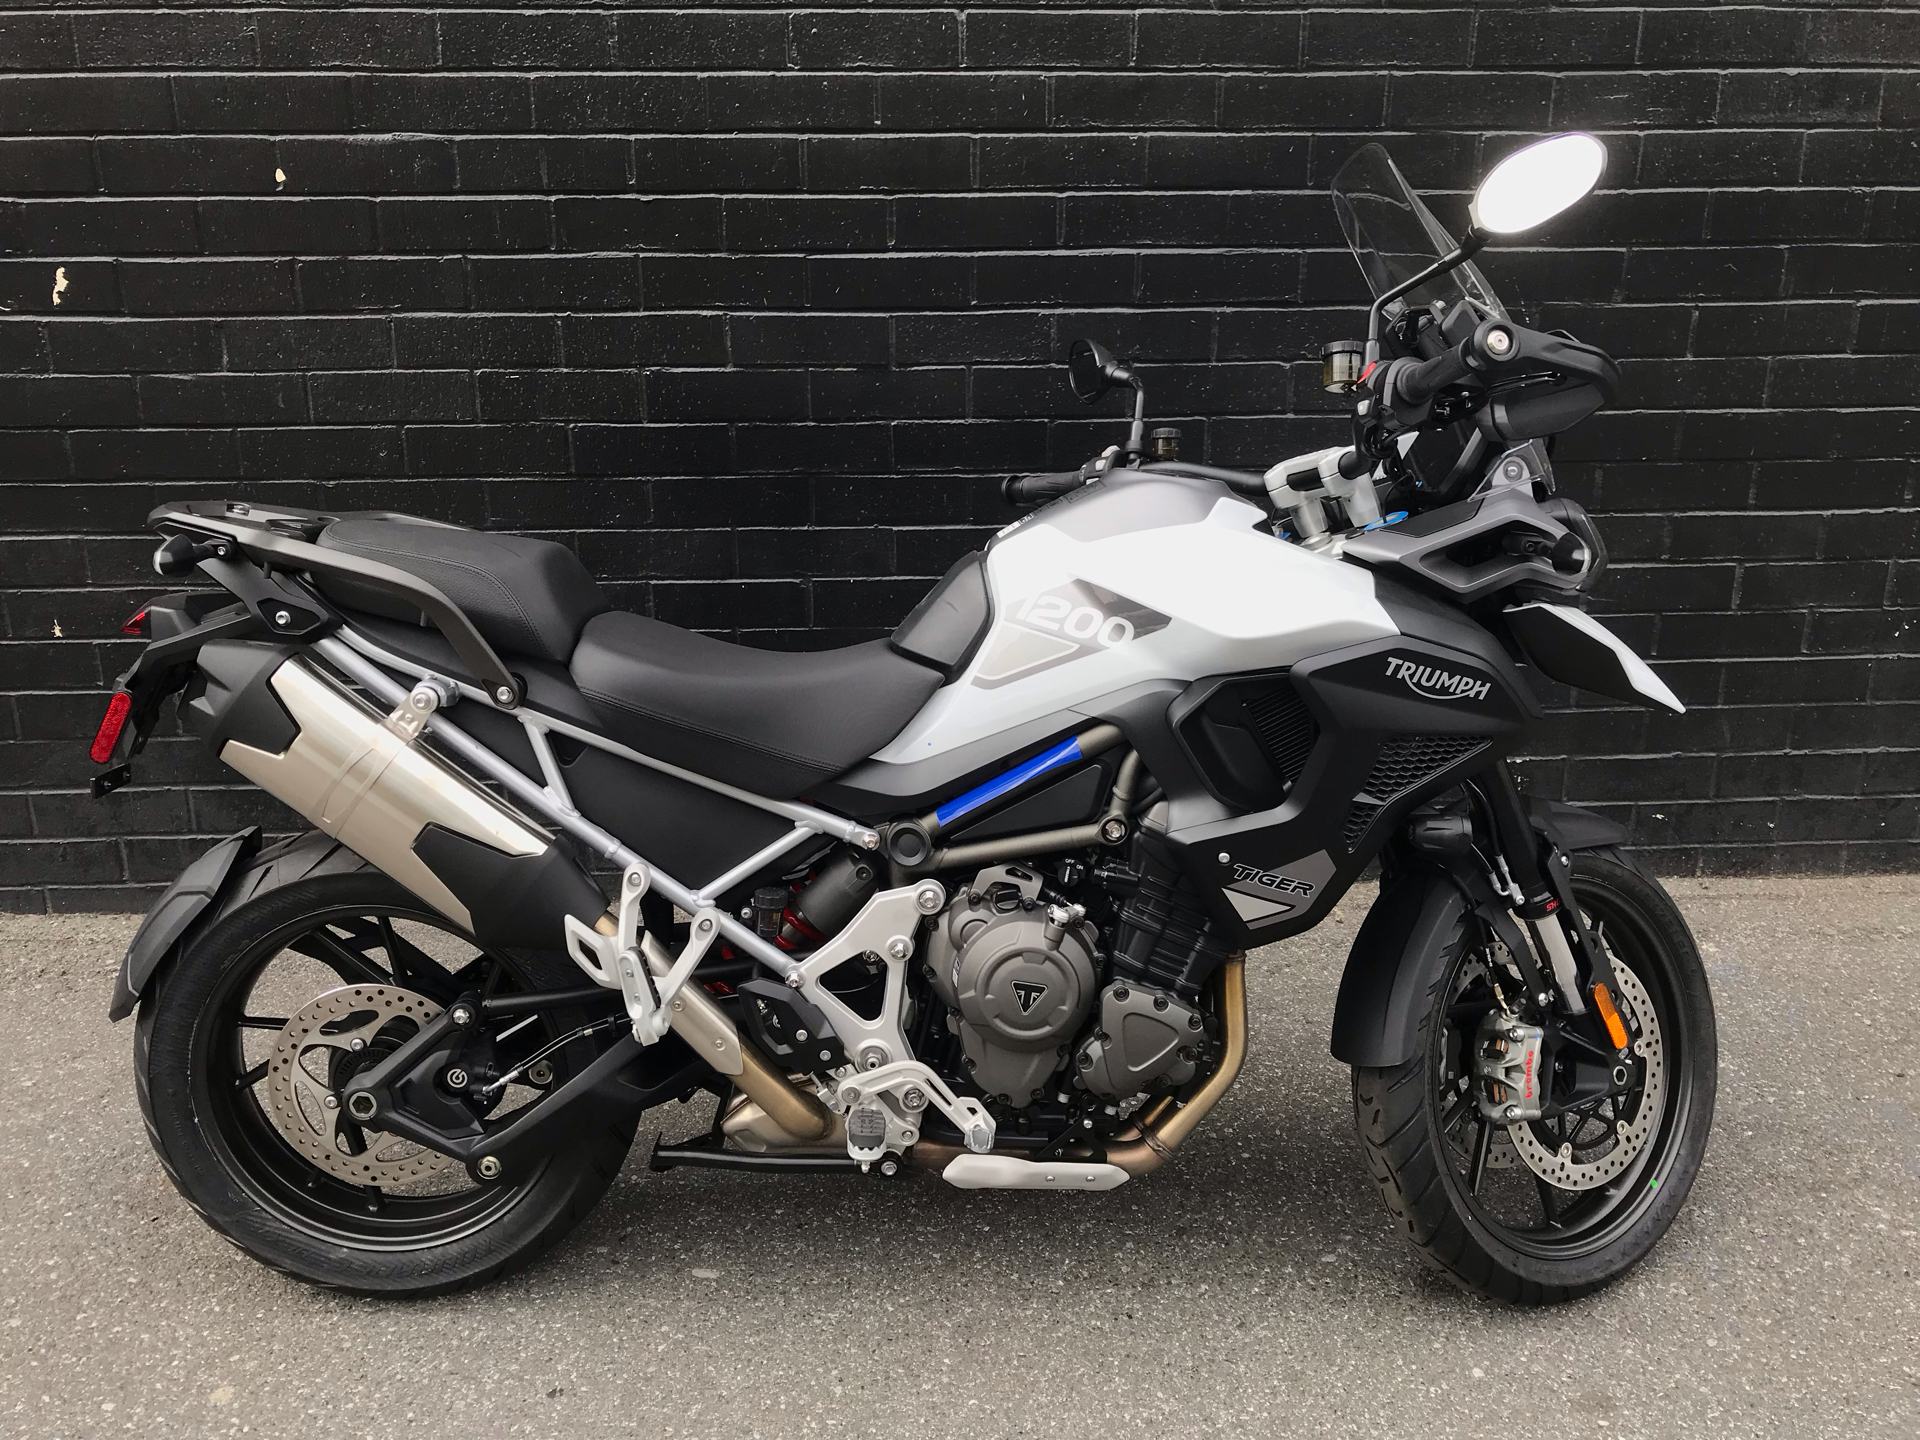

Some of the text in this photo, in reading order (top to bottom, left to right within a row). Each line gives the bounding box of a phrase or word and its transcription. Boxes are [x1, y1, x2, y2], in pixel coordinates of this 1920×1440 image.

[1016, 594, 1135, 651] 1200
[1385, 656, 1492, 700] TRIUMPH
[1233, 863, 1316, 898] TIGER
[1525, 1050, 1534, 1099] brembo
